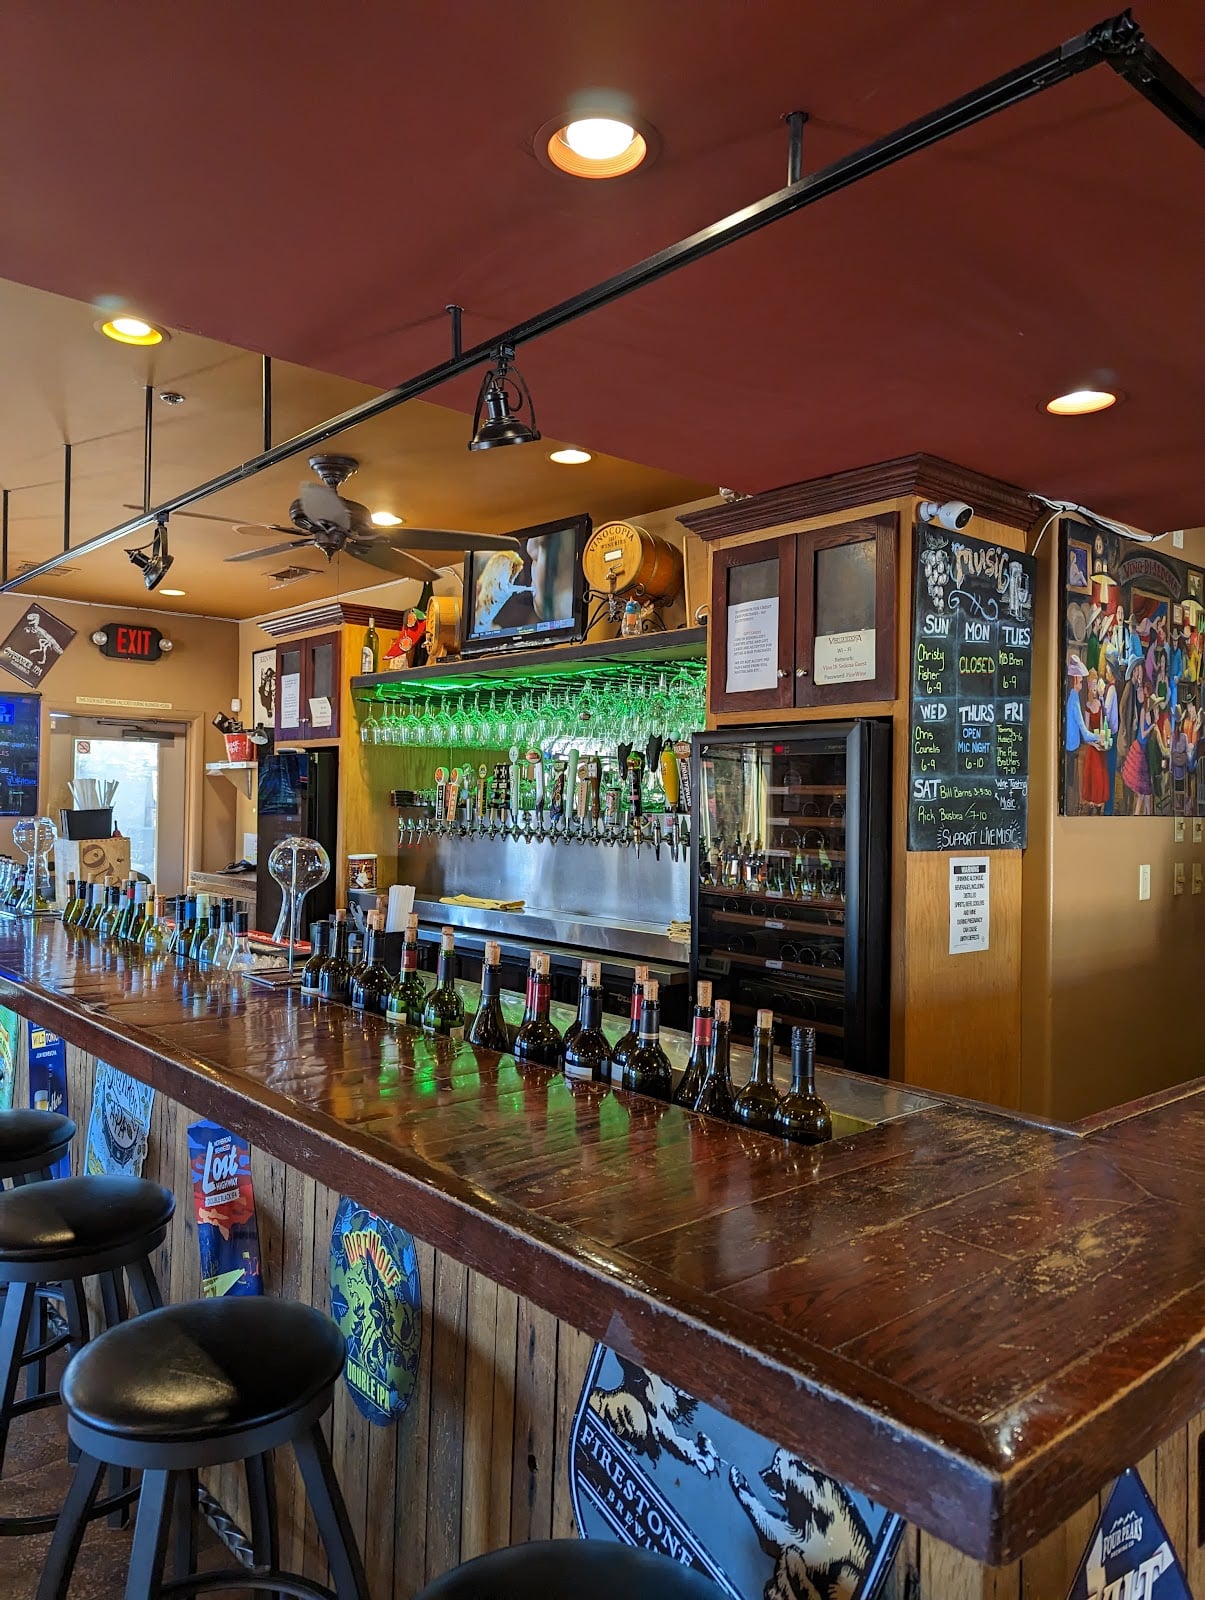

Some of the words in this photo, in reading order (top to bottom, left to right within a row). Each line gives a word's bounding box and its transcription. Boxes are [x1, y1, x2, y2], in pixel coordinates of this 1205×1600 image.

[590, 527, 634, 552] VINOCOPIA
[923, 614, 949, 635] SUN
[965, 622, 990, 641] MON
[117, 628, 151, 655] EXIT
[1002, 626, 1031, 646] TUES
[918, 665, 940, 680] Fisher
[959, 657, 995, 674] CLOSED
[926, 681, 942, 694] 6-9
[1002, 676, 1017, 689] 6-9
[920, 703, 947, 720] WED
[959, 704, 994, 723] THURS
[1004, 702, 1023, 721] FRI
[962, 728, 982, 739] OPEN
[958, 742, 970, 753] MIC
[971, 742, 990, 753] NIGHT
[921, 758, 936, 771] 6-9
[913, 779, 942, 799] SAT
[980, 826, 996, 846] LIVE
[203, 1141, 238, 1194] Lost
[347, 1359, 376, 1401] DOUBLE
[377, 1383, 391, 1411] IPA
[582, 1425, 693, 1568] FIRESTONE
[607, 1488, 659, 1554] BREWI
[1102, 1529, 1121, 1563] FOUR
[1121, 1516, 1143, 1541] PEAKS
